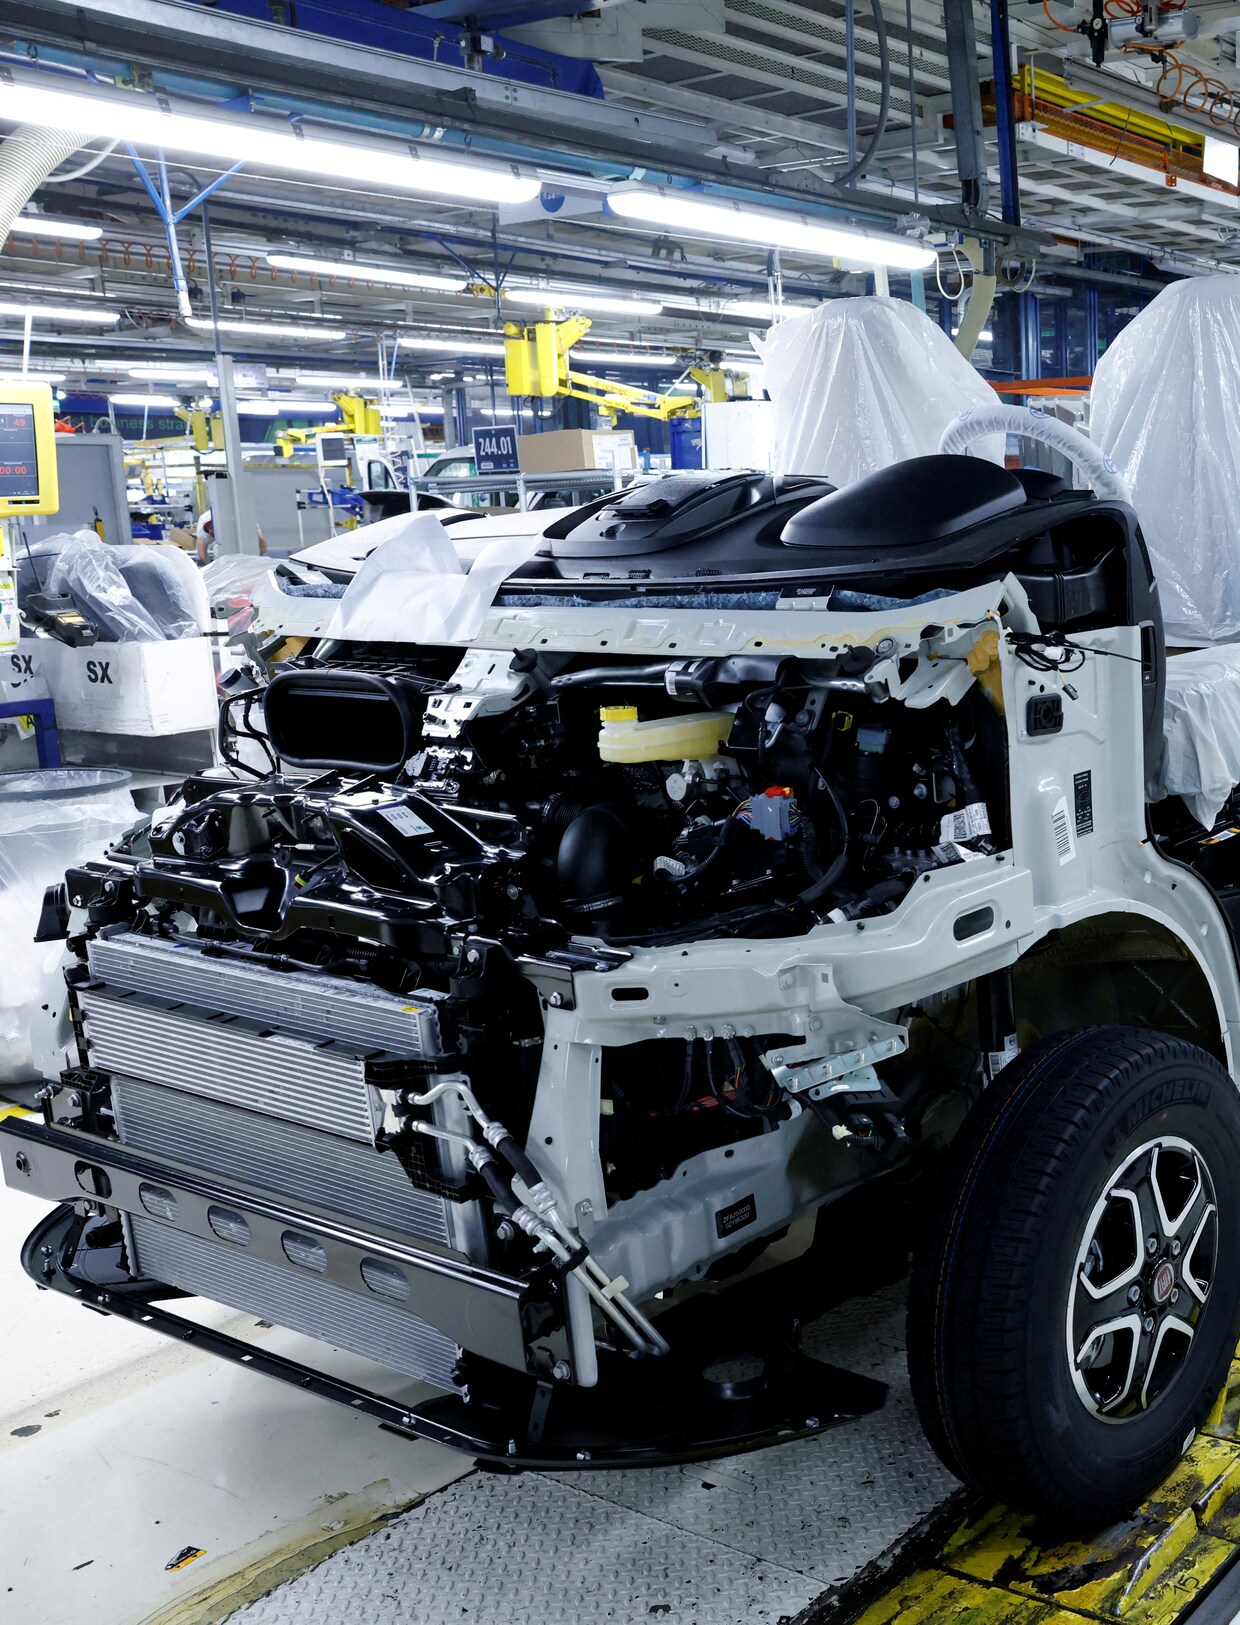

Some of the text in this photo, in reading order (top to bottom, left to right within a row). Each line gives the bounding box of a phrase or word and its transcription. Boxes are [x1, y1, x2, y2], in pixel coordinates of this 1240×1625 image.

[13, 418, 26, 427] 49
[478, 436, 513, 456] 244.01
[10, 654, 35, 675] SX
[86, 660, 113, 684] SX
[1128, 1081, 1209, 1126] MICHELIN
[1173, 1575, 1200, 1596] 15
